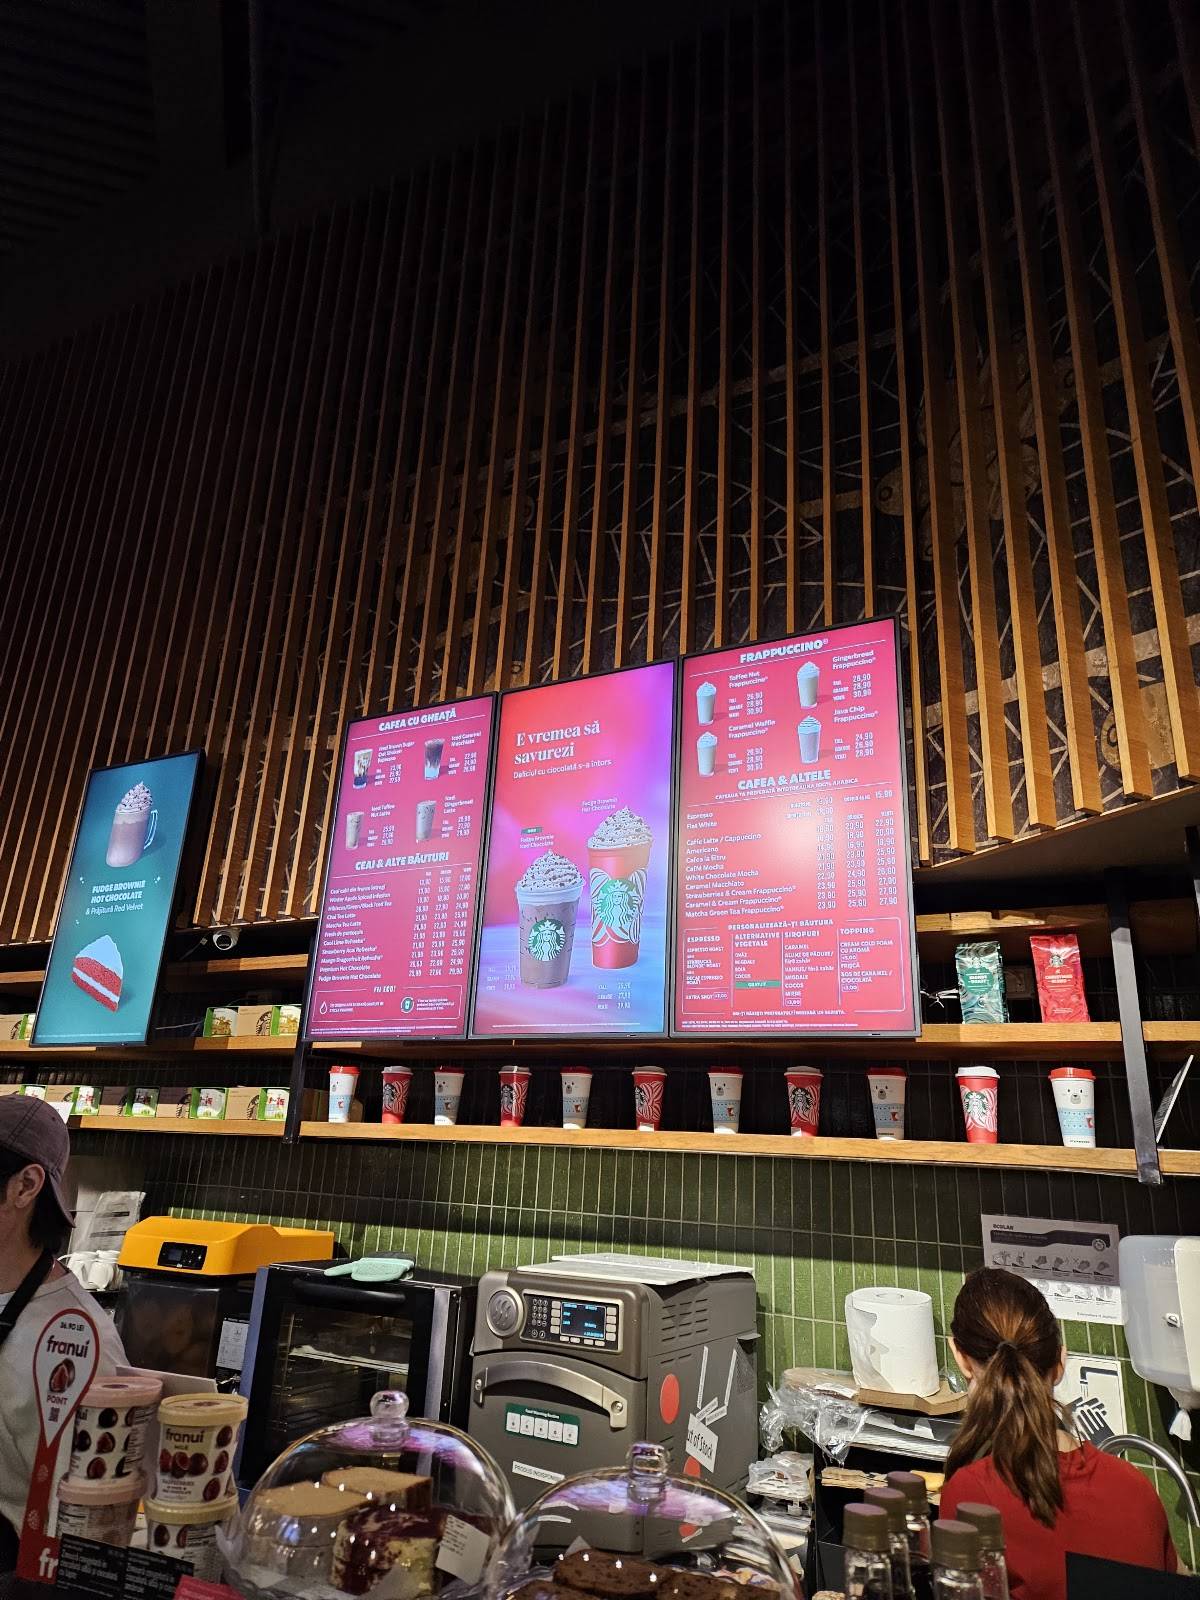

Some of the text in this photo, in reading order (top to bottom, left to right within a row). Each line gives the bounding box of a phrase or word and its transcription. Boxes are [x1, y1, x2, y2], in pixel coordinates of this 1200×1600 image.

[833, 650, 874, 663] Gingerbread
[729, 673, 748, 681] Toffee
[834, 707, 849, 715] Java
[379, 718, 407, 731] CAFEA
[408, 717, 419, 726] CU
[729, 723, 753, 732] Caramel
[516, 720, 600, 746] E vremea să
[514, 743, 575, 765] savurezi
[514, 770, 536, 779] Deliciul
[547, 764, 577, 775] ciocolată
[738, 770, 831, 790] CAFEA & ALTELE
[687, 812, 713, 820] Espresso
[845, 818, 894, 830] 20,90 22,90
[725, 833, 761, 843] Cappuccino
[686, 846, 718, 855] Americano
[355, 852, 449, 871] CEAI & ALTE BĂUTURI
[706, 872, 736, 880] Chocolate
[92, 880, 145, 893] FUDGE BROWNIE
[91, 891, 142, 903] HOT CHOCOLATE
[686, 891, 724, 900] Strawberries
[114, 904, 125, 912] Red
[126, 903, 143, 911] Velvet
[686, 901, 711, 909] Caramel
[818, 901, 835, 910] 23,90
[735, 932, 780, 940] ALTERNATIVE
[47, 1395, 68, 1405] POINT
